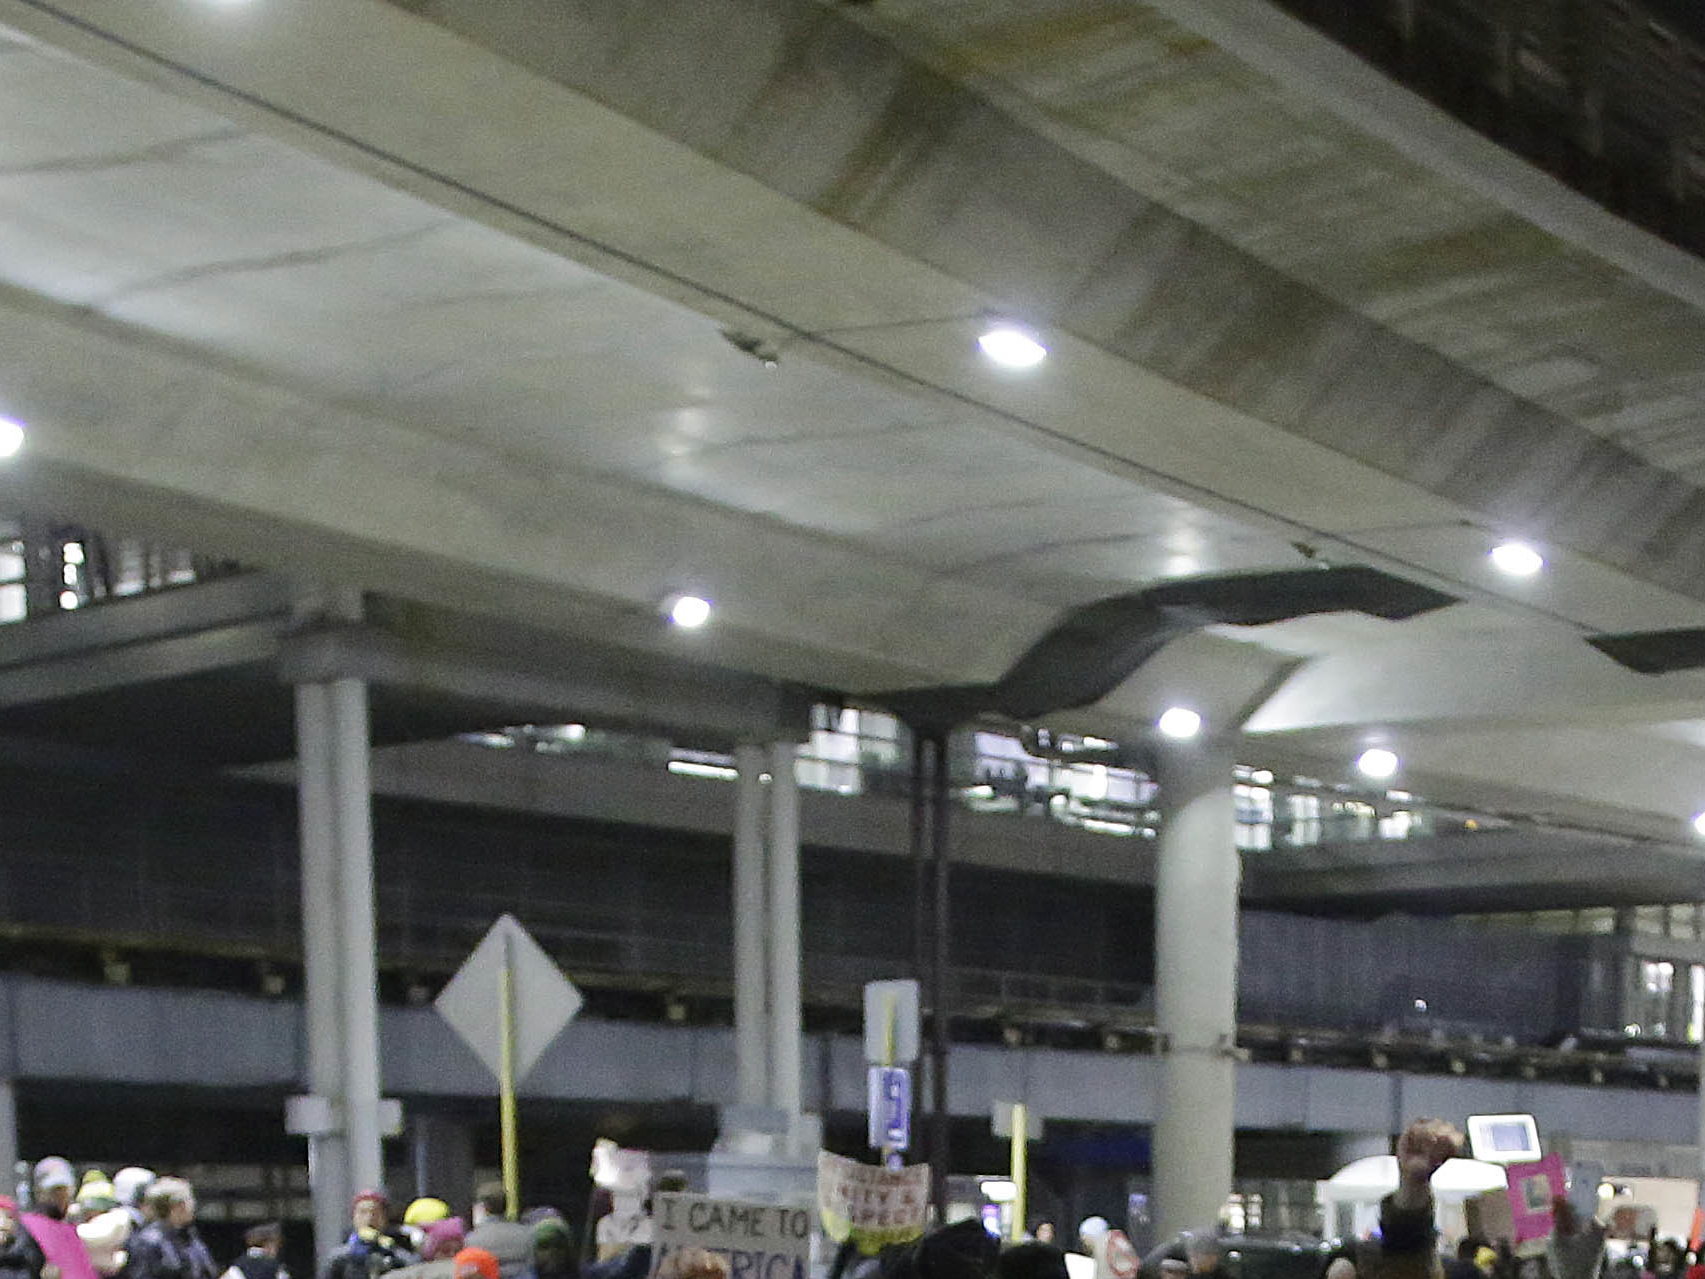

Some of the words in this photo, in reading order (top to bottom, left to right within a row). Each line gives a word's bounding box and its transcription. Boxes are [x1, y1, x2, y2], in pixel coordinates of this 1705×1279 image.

[661, 1203, 676, 1231] I
[689, 1203, 764, 1237] CAME
[778, 1208, 809, 1239] TO
